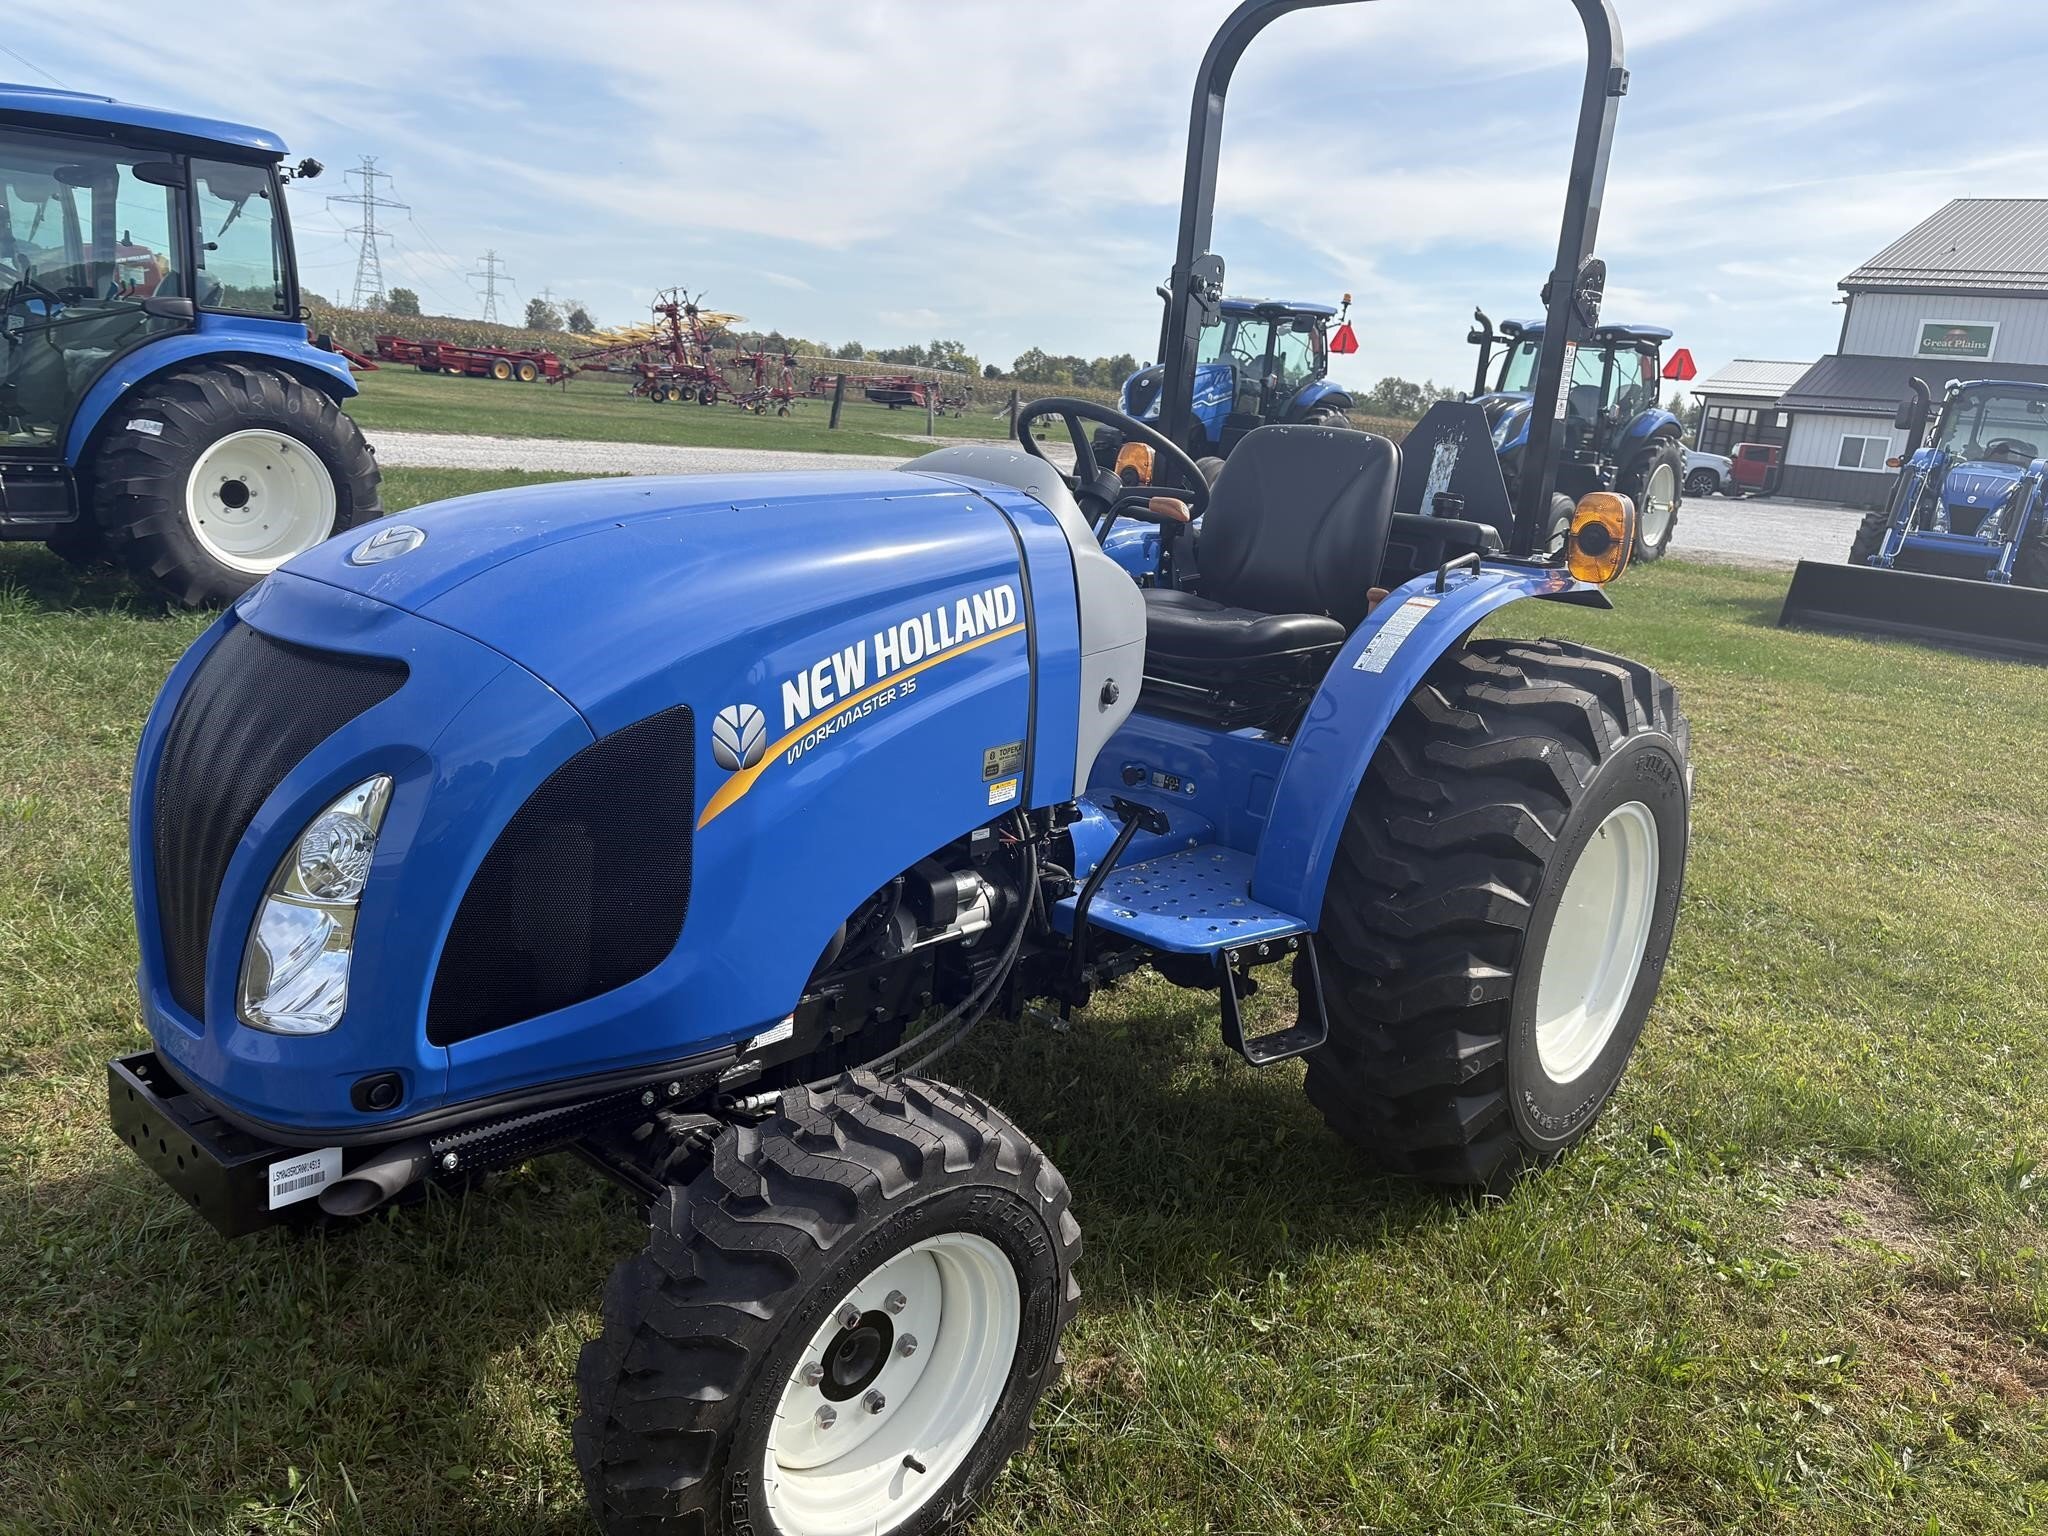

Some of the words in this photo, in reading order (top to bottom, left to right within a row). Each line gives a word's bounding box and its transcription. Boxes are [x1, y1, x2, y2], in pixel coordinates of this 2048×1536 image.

[1923, 338, 1952, 347] Great
[1954, 339, 1987, 349] Plains
[782, 639, 867, 731] NEW
[873, 584, 1016, 678] HOLLAND
[786, 688, 897, 766] WORKMASTER
[899, 677, 917, 698] 35
